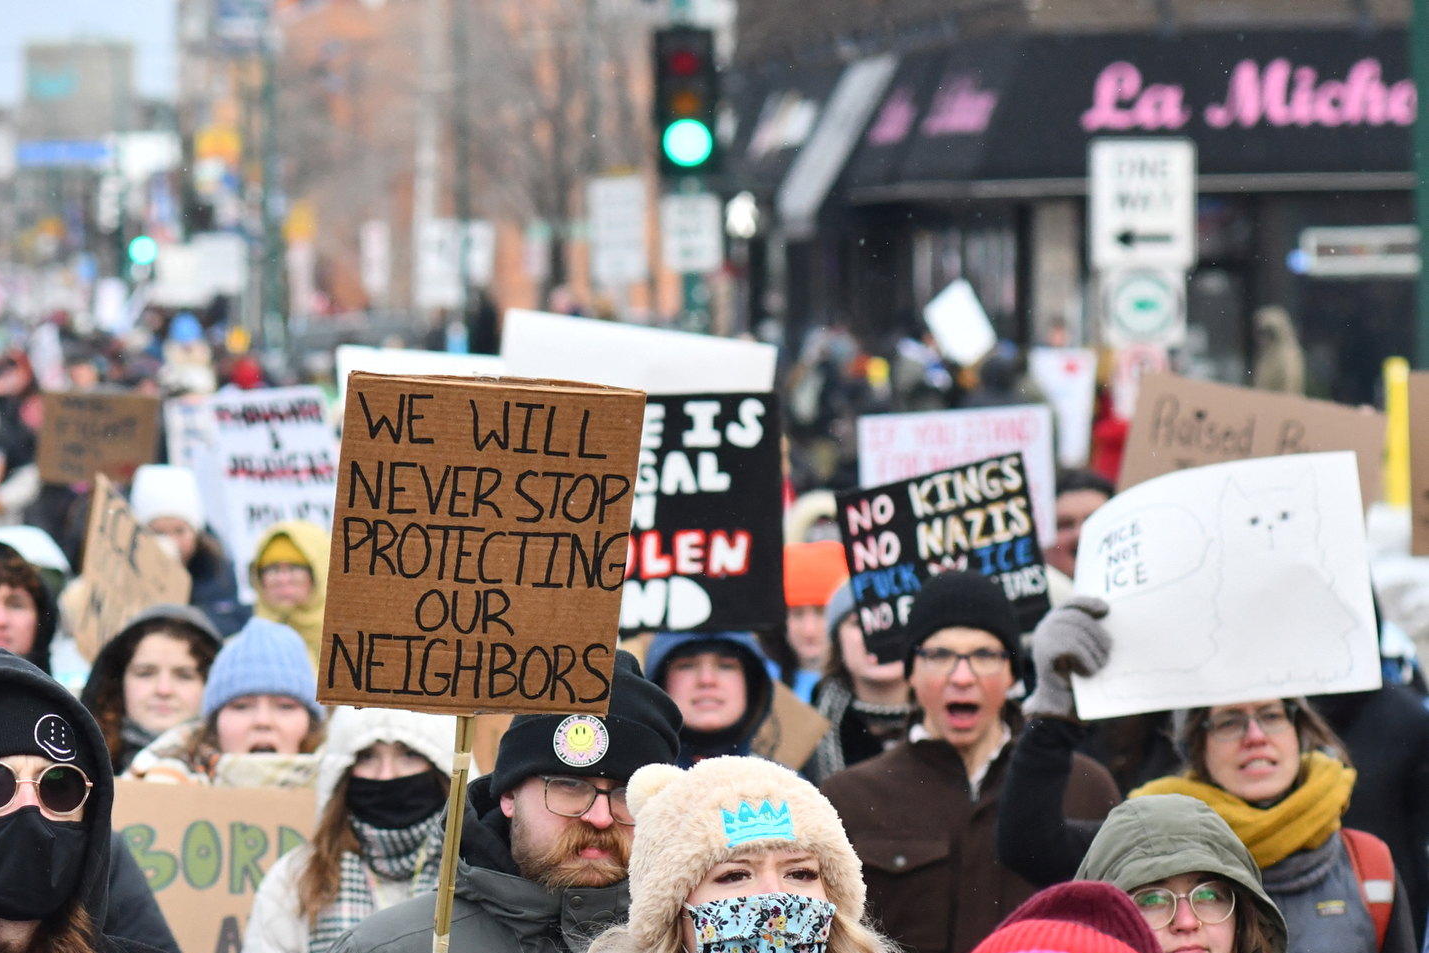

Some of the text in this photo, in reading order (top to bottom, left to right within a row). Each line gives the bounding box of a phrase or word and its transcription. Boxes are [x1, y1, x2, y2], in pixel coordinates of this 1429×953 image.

[1081, 60, 1191, 131] La
[1117, 159, 1174, 180] ONE
[357, 391, 608, 460] WE WILL
[681, 397, 767, 449] IS
[1150, 392, 1310, 457] Raised B
[348, 460, 631, 524] NEVER STOP
[846, 493, 895, 537] NO
[908, 456, 1024, 519] KINGS
[343, 516, 632, 592] PROTECTING
[852, 496, 1032, 573] NO NAZIS
[1106, 543, 1140, 568] NOT
[852, 537, 1035, 601] FUCK ICE
[1105, 562, 1148, 593] ICE
[414, 588, 515, 637] OUR
[619, 575, 713, 631] ND
[860, 601, 895, 636] NO
[327, 630, 611, 704] NEIGHBORS
